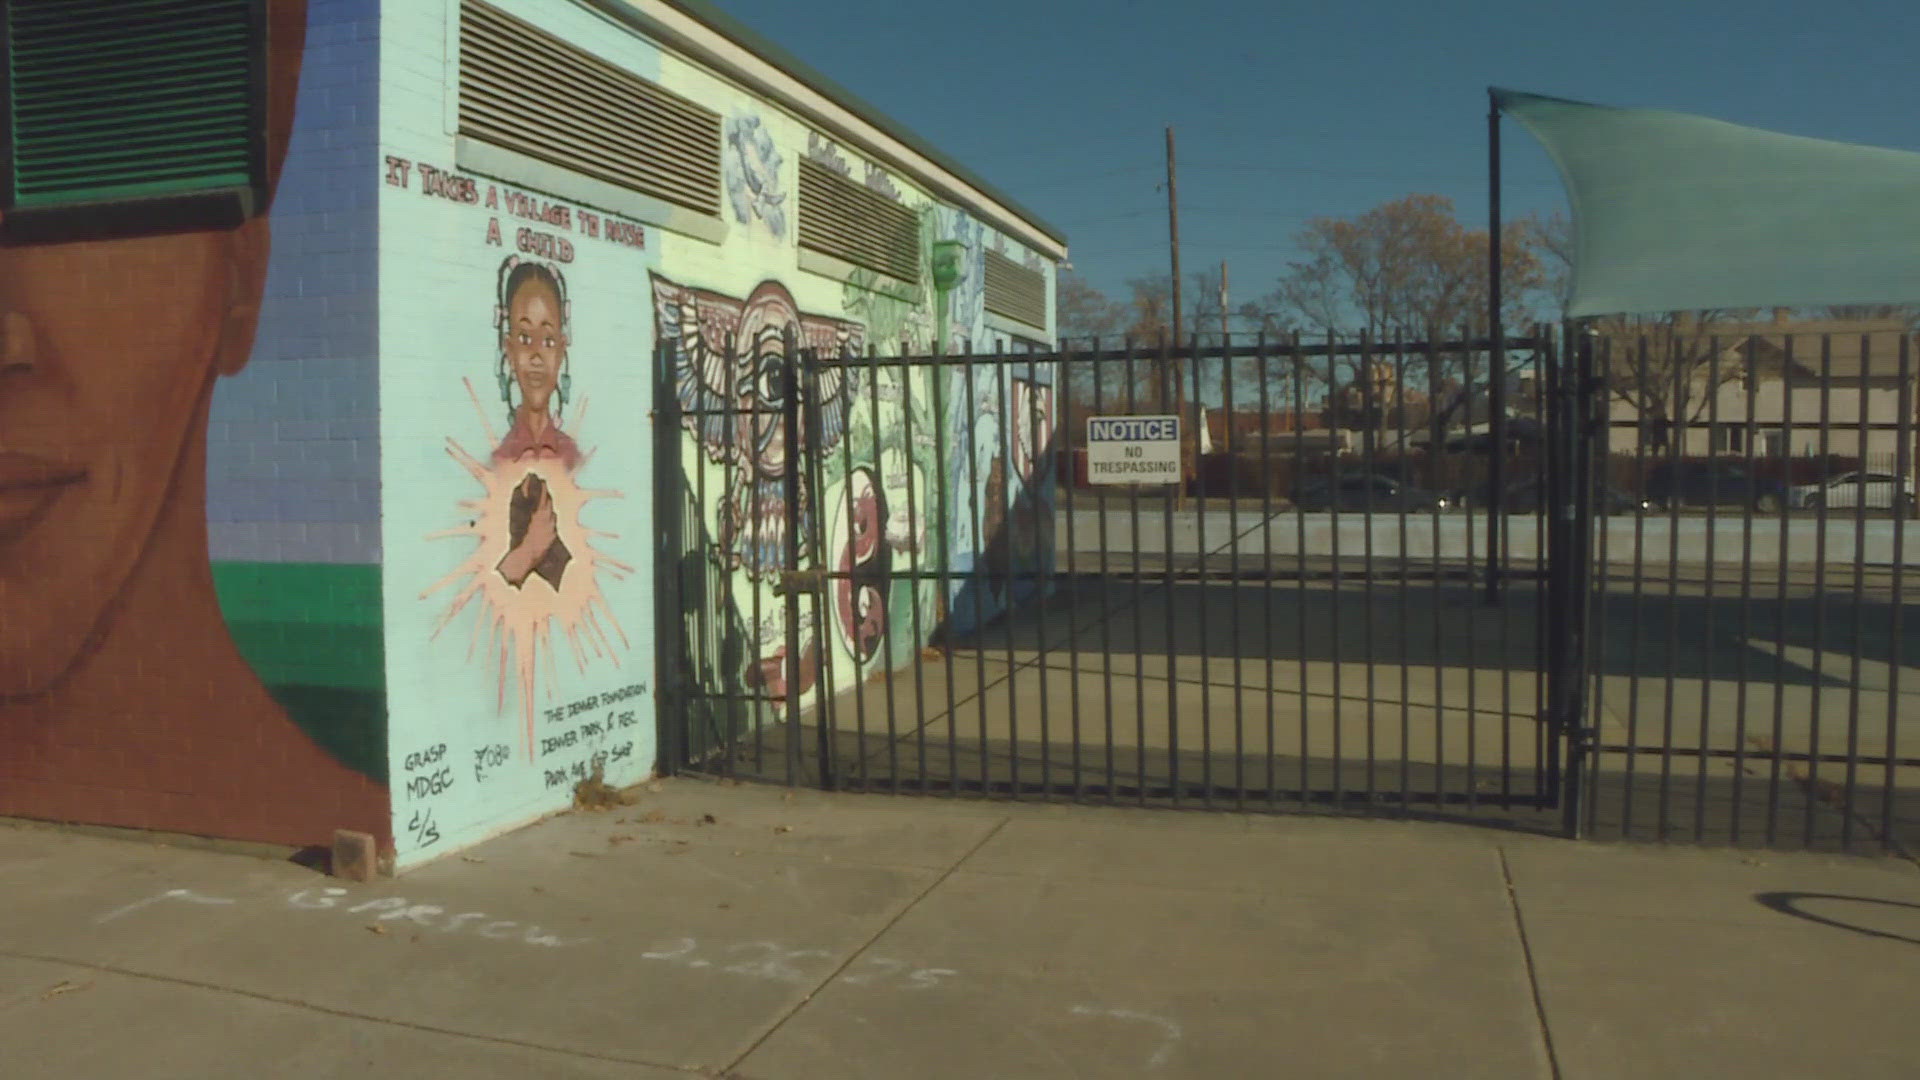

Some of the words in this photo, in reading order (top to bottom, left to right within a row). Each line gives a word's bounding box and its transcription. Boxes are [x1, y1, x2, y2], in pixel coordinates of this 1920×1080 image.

[385, 155, 411, 188] IT
[418, 162, 479, 205] TAKES
[486, 186, 498, 210] A
[504, 188, 572, 231] VILLAGE
[577, 209, 600, 238] TO
[604, 218, 646, 250] RAISE
[486, 217, 502, 247] A
[516, 227, 575, 263] CHILD
[1093, 420, 1175, 441] NOTICE
[1125, 446, 1143, 458] NO
[1093, 461, 1177, 474] TRESPASSING
[544, 706, 565, 724] THE
[541, 730, 579, 757] DENVER
[404, 743, 448, 772] GRASP
[407, 766, 454, 801] MDGC
